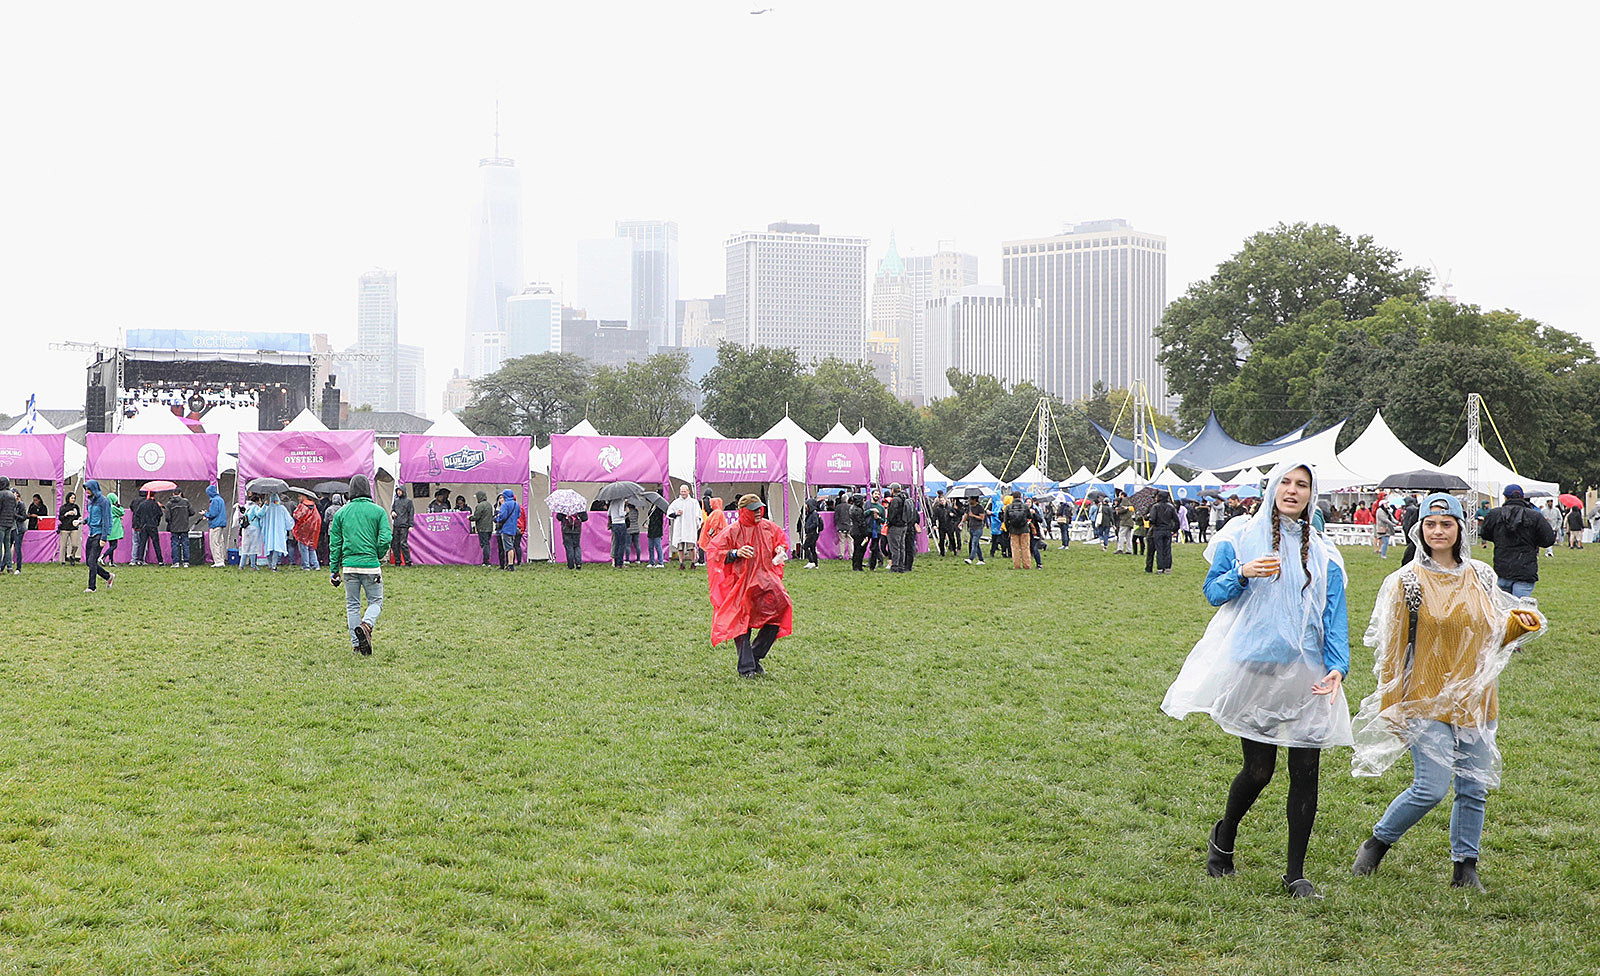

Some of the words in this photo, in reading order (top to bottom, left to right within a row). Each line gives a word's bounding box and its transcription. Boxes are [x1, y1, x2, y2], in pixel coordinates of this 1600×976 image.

[284, 456, 324, 464] OYSTERS
[444, 454, 461, 466] BLUE
[718, 453, 767, 469] BRAVEN
